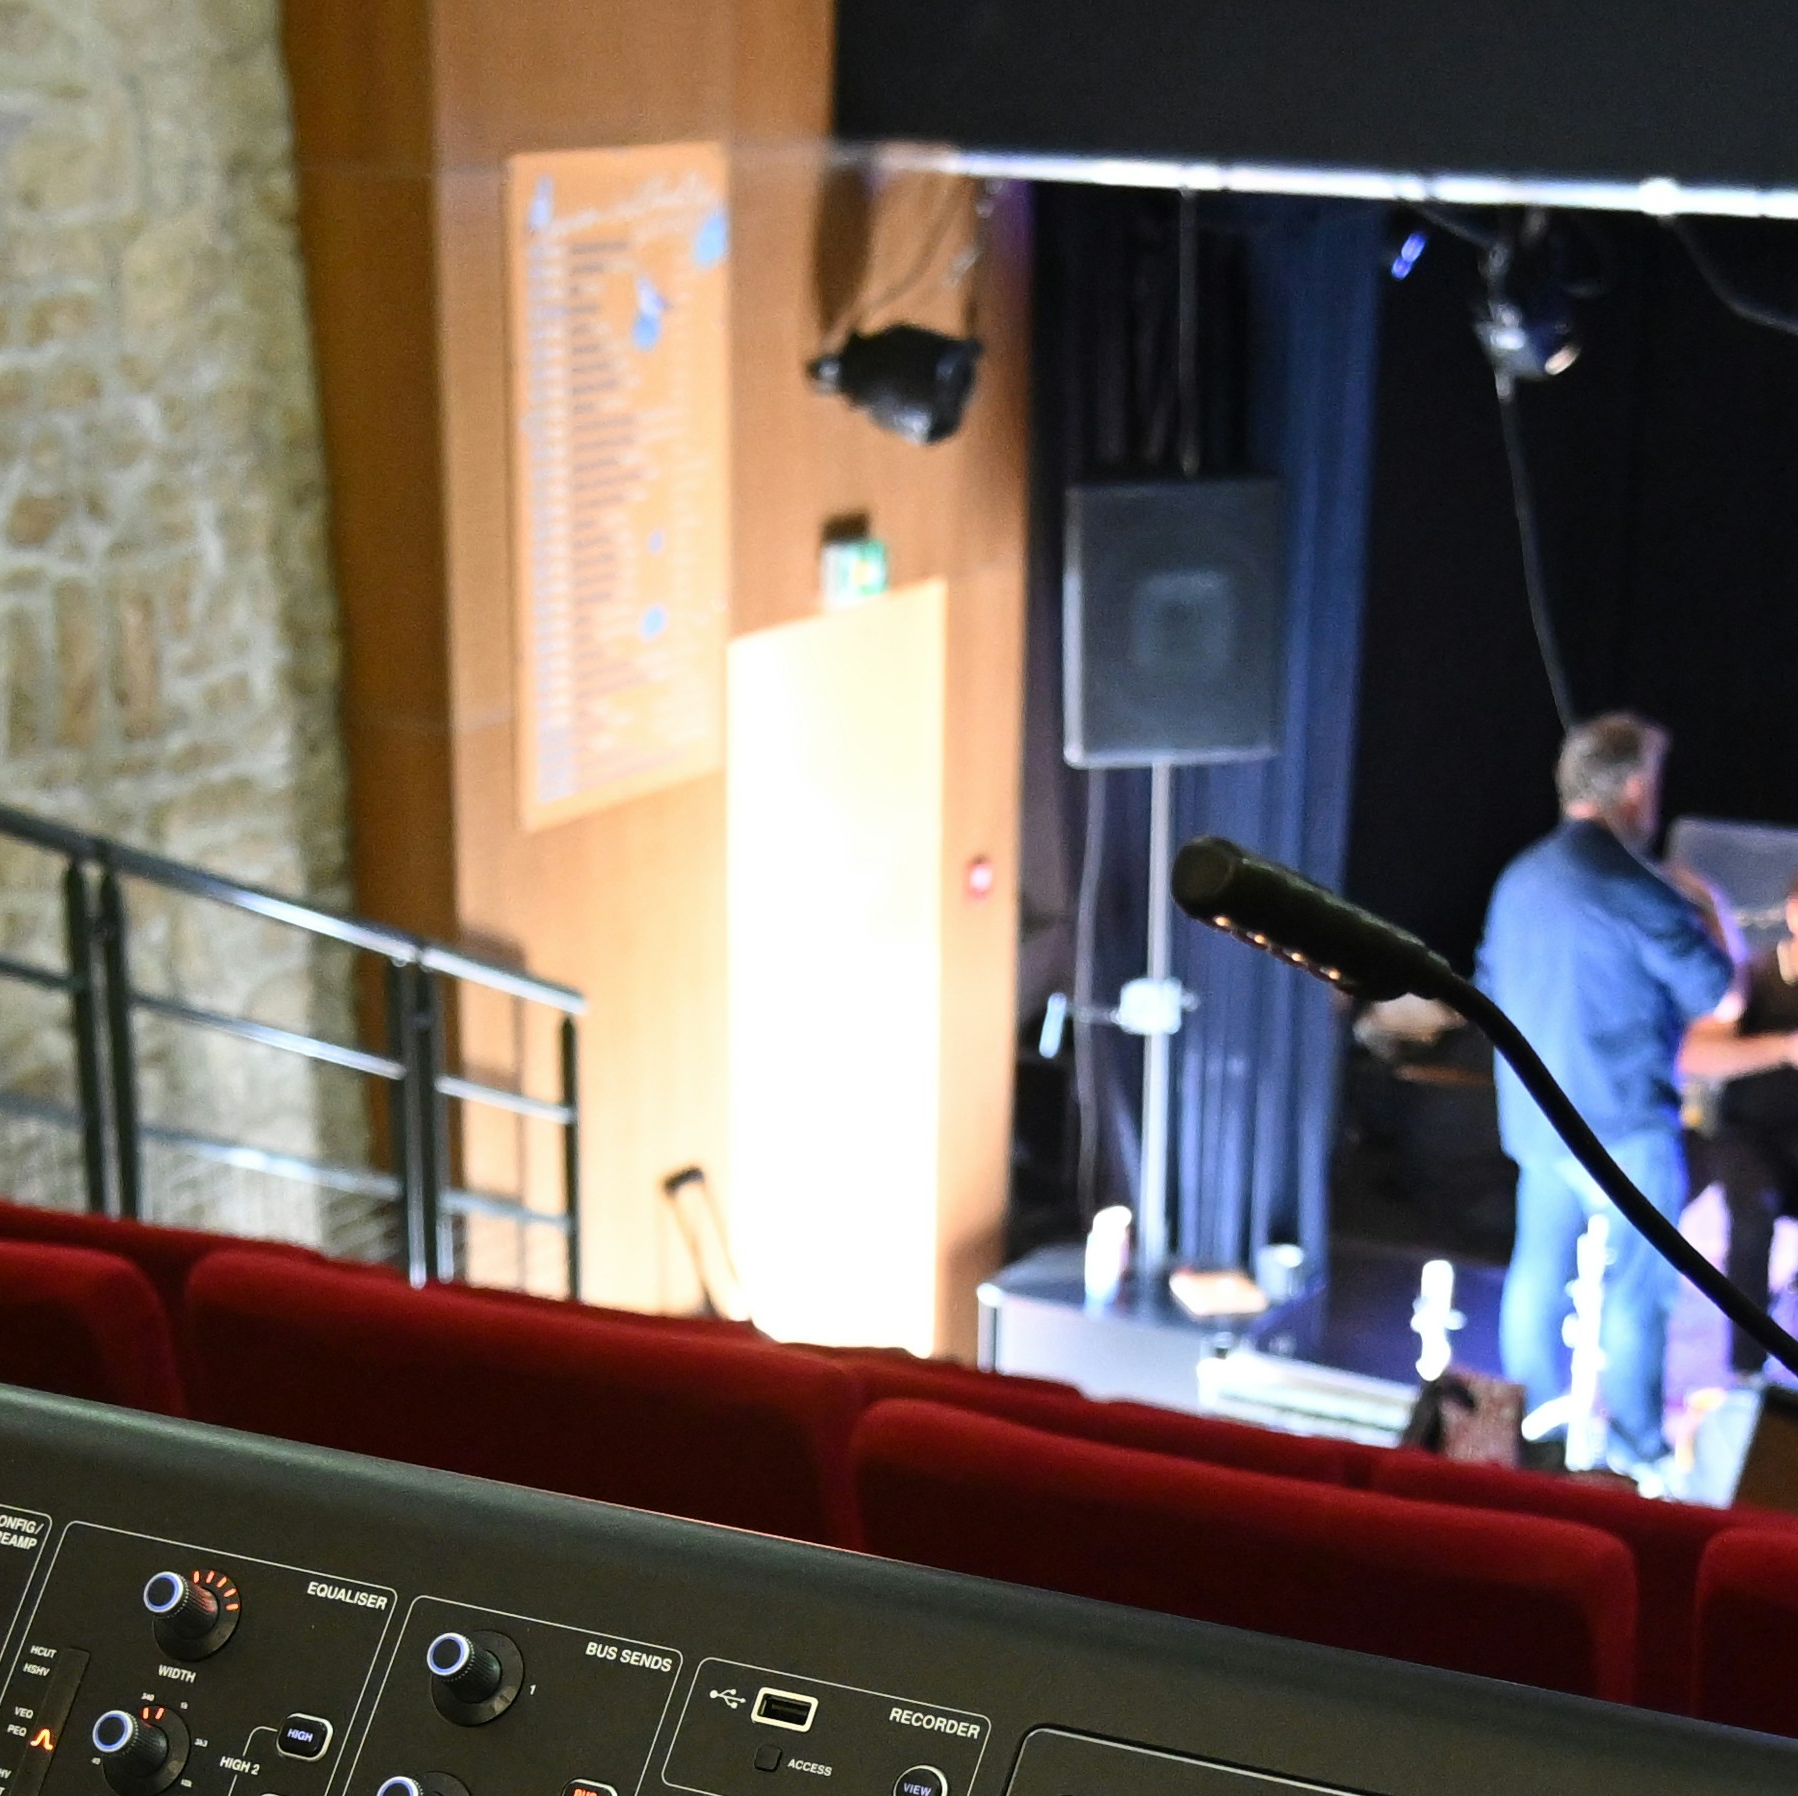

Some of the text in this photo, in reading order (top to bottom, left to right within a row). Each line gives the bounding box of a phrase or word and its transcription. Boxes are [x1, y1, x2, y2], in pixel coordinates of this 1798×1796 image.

[306, 1581, 388, 1611] EQUALISER
[30, 1645, 57, 1659] HCUT
[585, 1641, 673, 1673] BUS SENDS
[22, 1662, 51, 1677] HSHV
[158, 1664, 197, 1684] WIDTH
[530, 1684, 536, 1695] 1
[14, 1706, 34, 1719] VEQ
[7, 1723, 27, 1737] PEQ
[889, 1707, 981, 1739] RECORDER
[287, 1728, 314, 1743] HIGH
[220, 1755, 261, 1776] HIGH 2
[787, 1758, 833, 1777] ACCESS
[903, 1782, 932, 1796] VIEW
